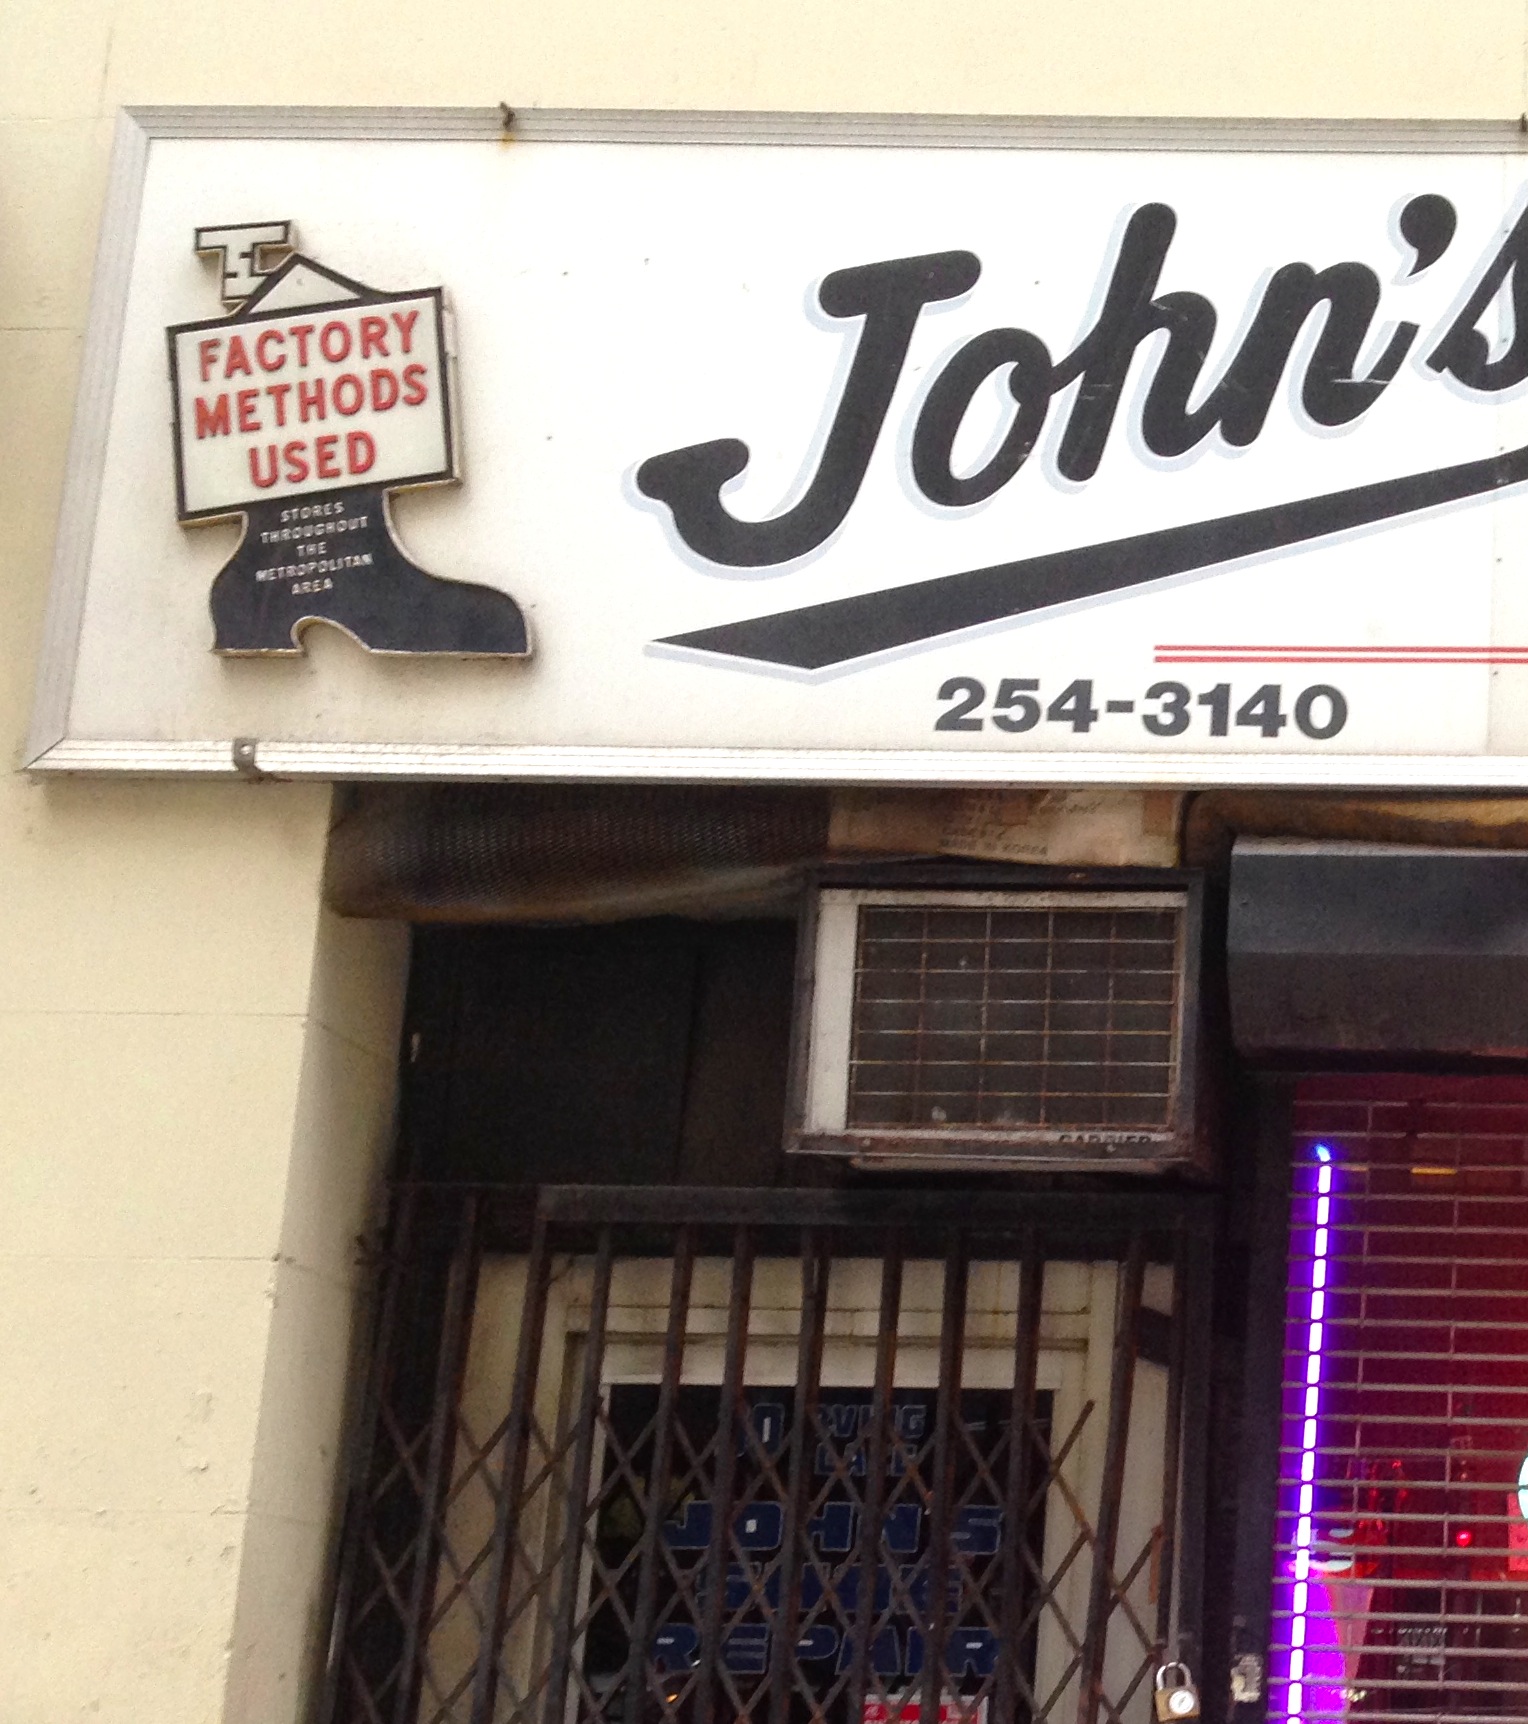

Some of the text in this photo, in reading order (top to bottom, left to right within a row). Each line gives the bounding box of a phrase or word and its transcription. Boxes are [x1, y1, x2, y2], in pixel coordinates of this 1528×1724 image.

[197, 309, 420, 382] FACTORY
[194, 363, 429, 440] METHODS
[248, 430, 377, 488] USED
[279, 501, 346, 523] STORES
[259, 515, 369, 544] THROUGHOUT
[296, 541, 328, 556] THE
[254, 553, 375, 583] METROPOLITAN
[291, 577, 334, 596] AREA
[934, 675, 1350, 741] 254-3140
